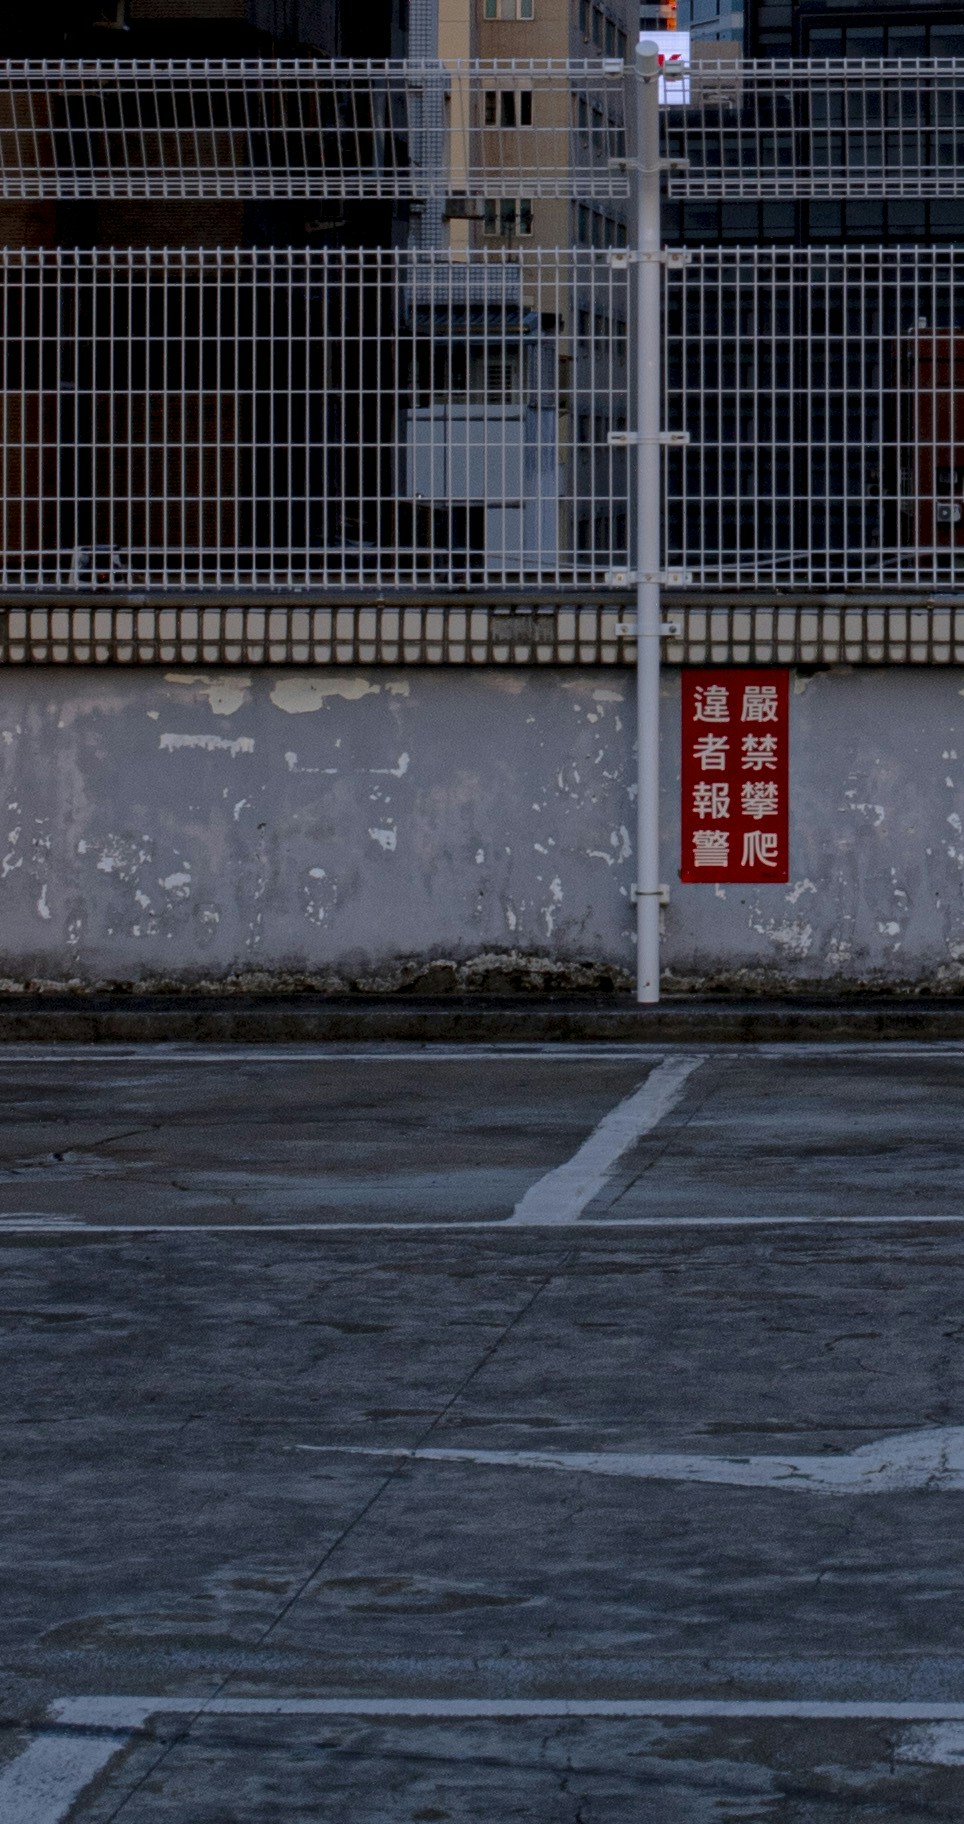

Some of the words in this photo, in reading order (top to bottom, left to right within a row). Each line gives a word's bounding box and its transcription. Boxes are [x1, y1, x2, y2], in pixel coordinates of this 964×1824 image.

[692, 684, 731, 868] 違者報警
[740, 684, 779, 867] 嚴禁攀爬
